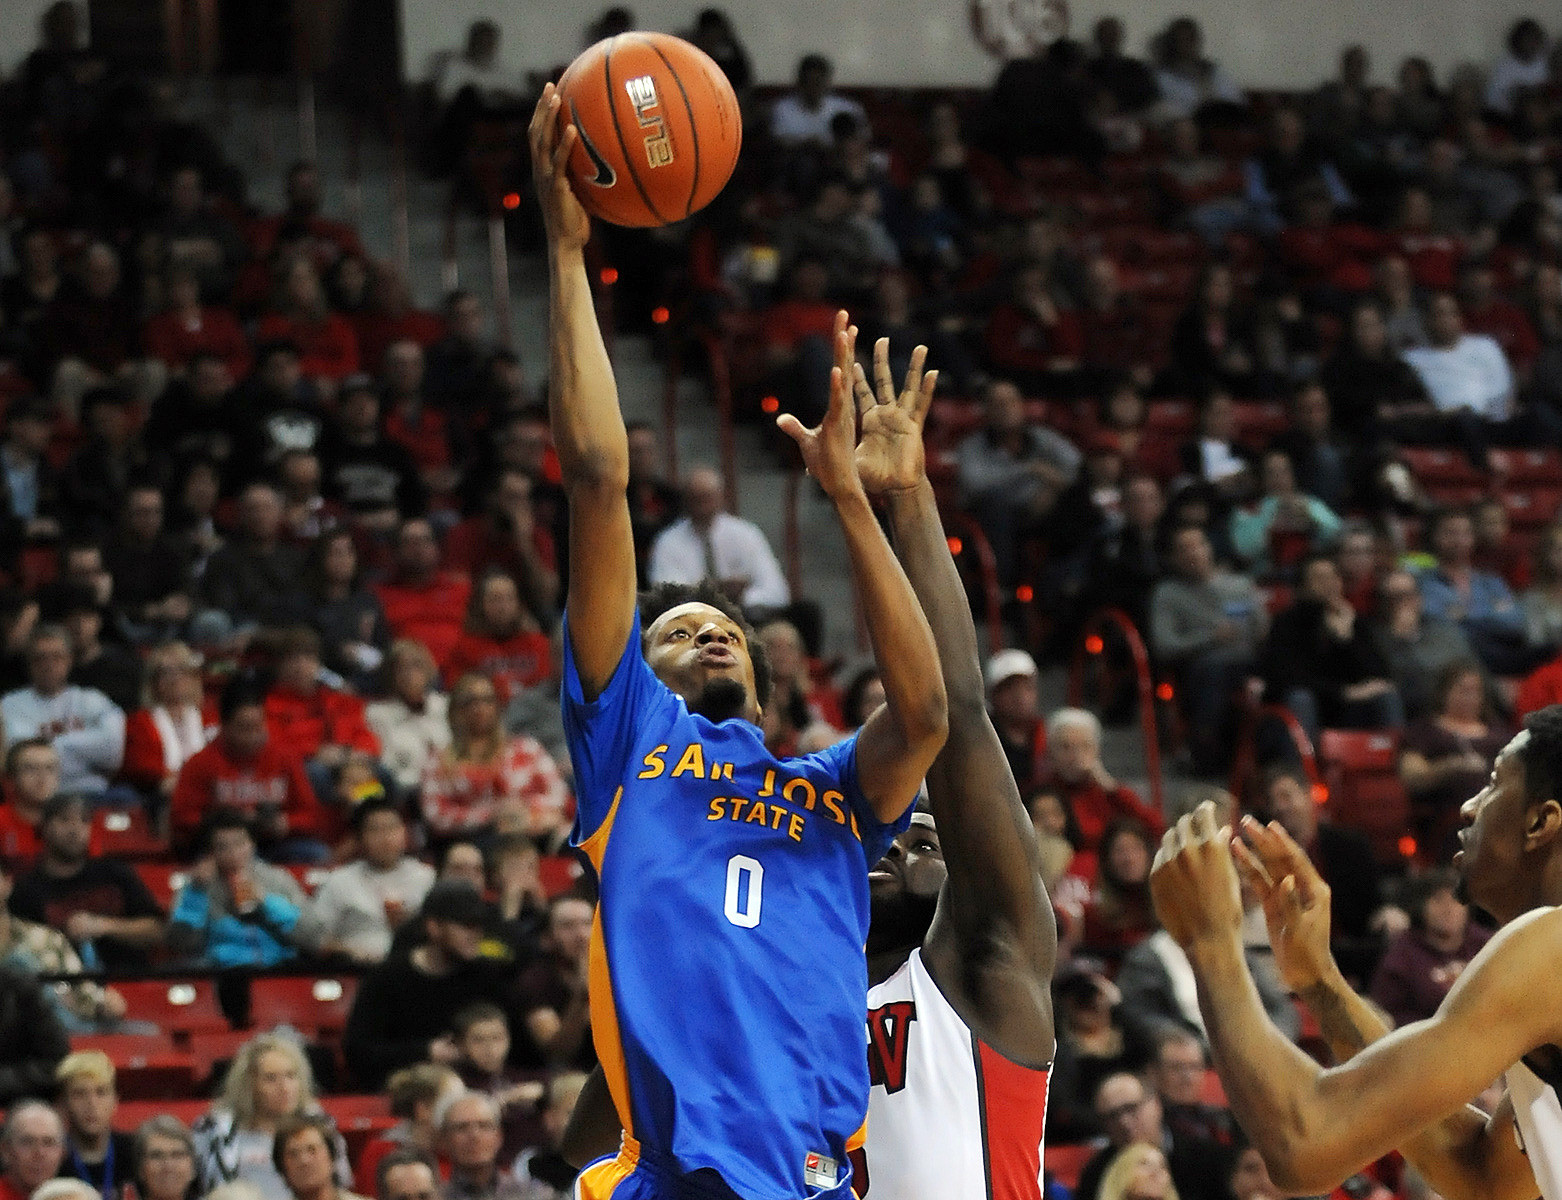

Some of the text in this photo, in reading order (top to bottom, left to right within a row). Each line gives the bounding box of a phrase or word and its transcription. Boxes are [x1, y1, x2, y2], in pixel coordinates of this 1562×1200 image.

[625, 75, 674, 169] ELITE
[707, 797, 806, 842] STATE
[724, 854, 764, 929] 0
